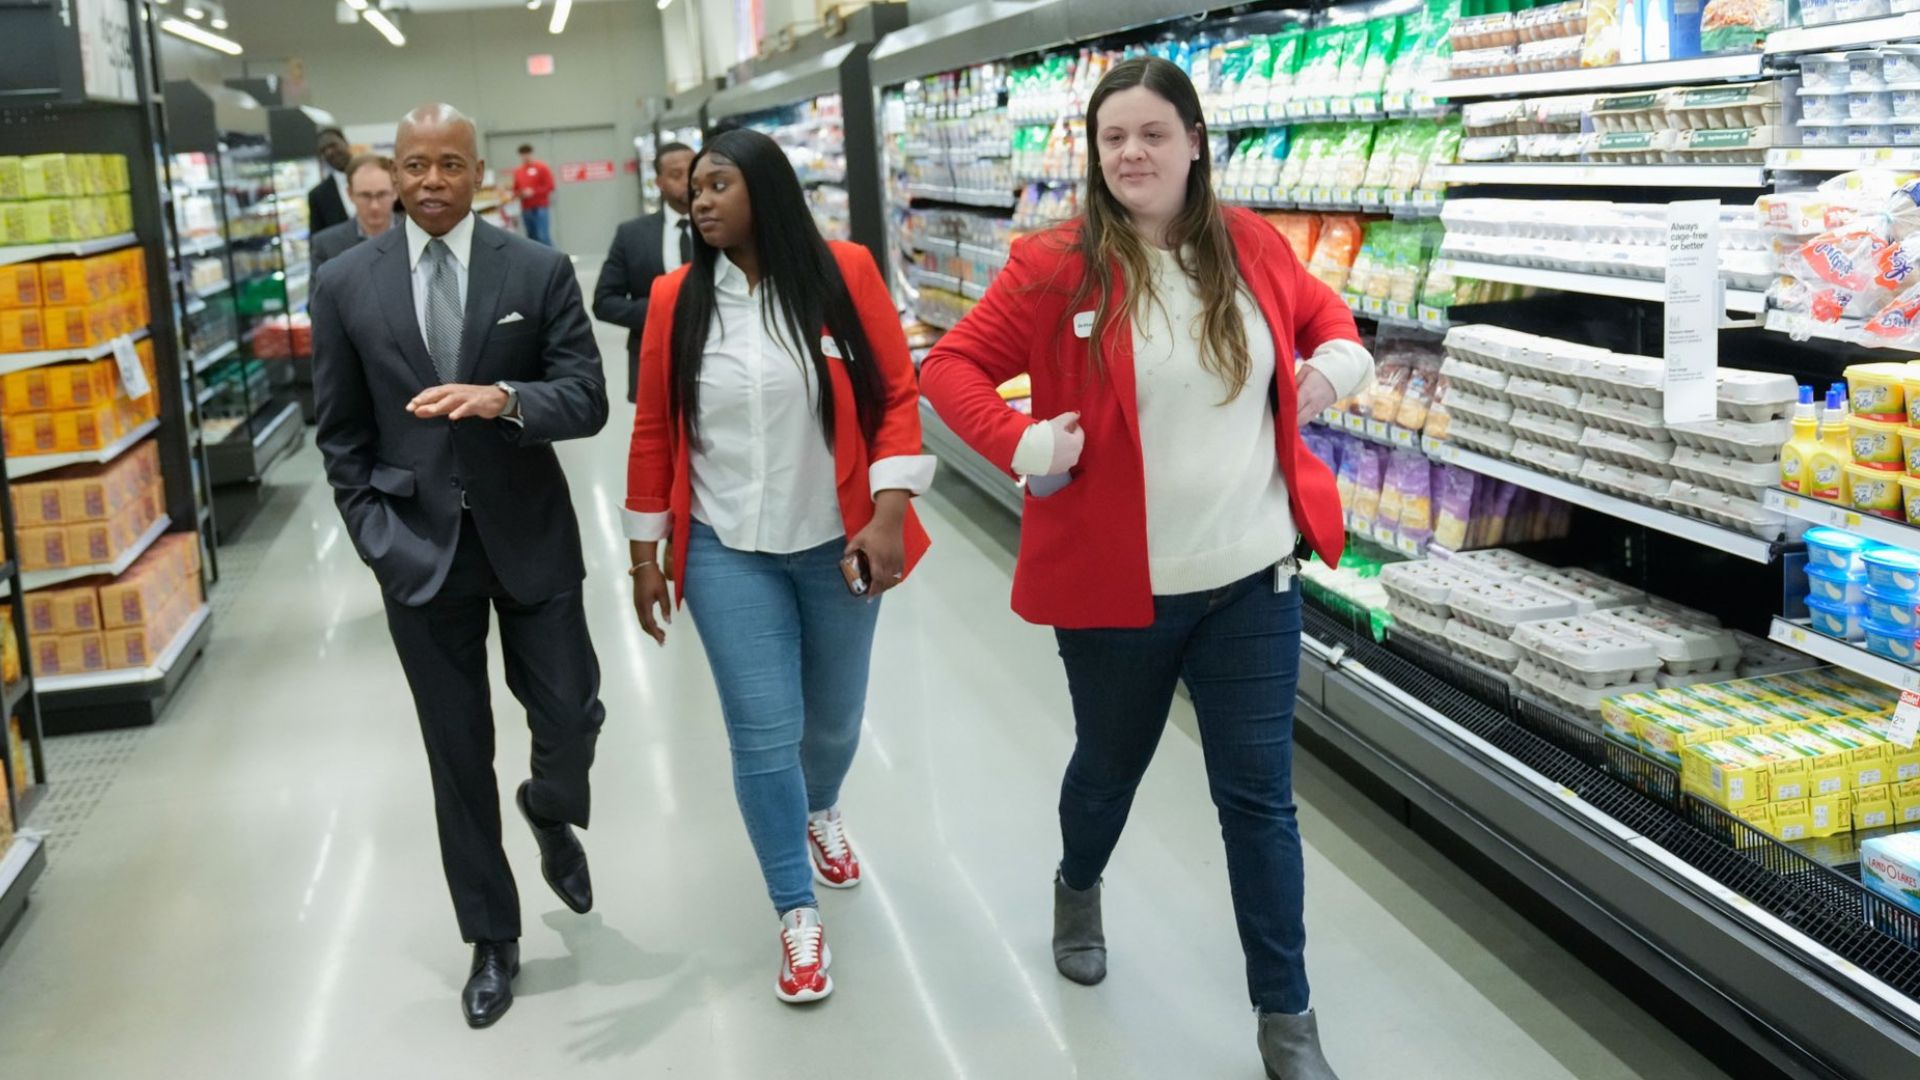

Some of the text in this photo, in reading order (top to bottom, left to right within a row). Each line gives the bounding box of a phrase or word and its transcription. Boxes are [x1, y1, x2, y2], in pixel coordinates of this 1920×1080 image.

[1671, 223, 1698, 232] Always
[1670, 232, 1708, 241] cage-free
[1680, 242, 1704, 250] better
[1868, 856, 1886, 873] LAND
[1887, 864, 1897, 879] O
[1897, 871, 1917, 888] LAKES
